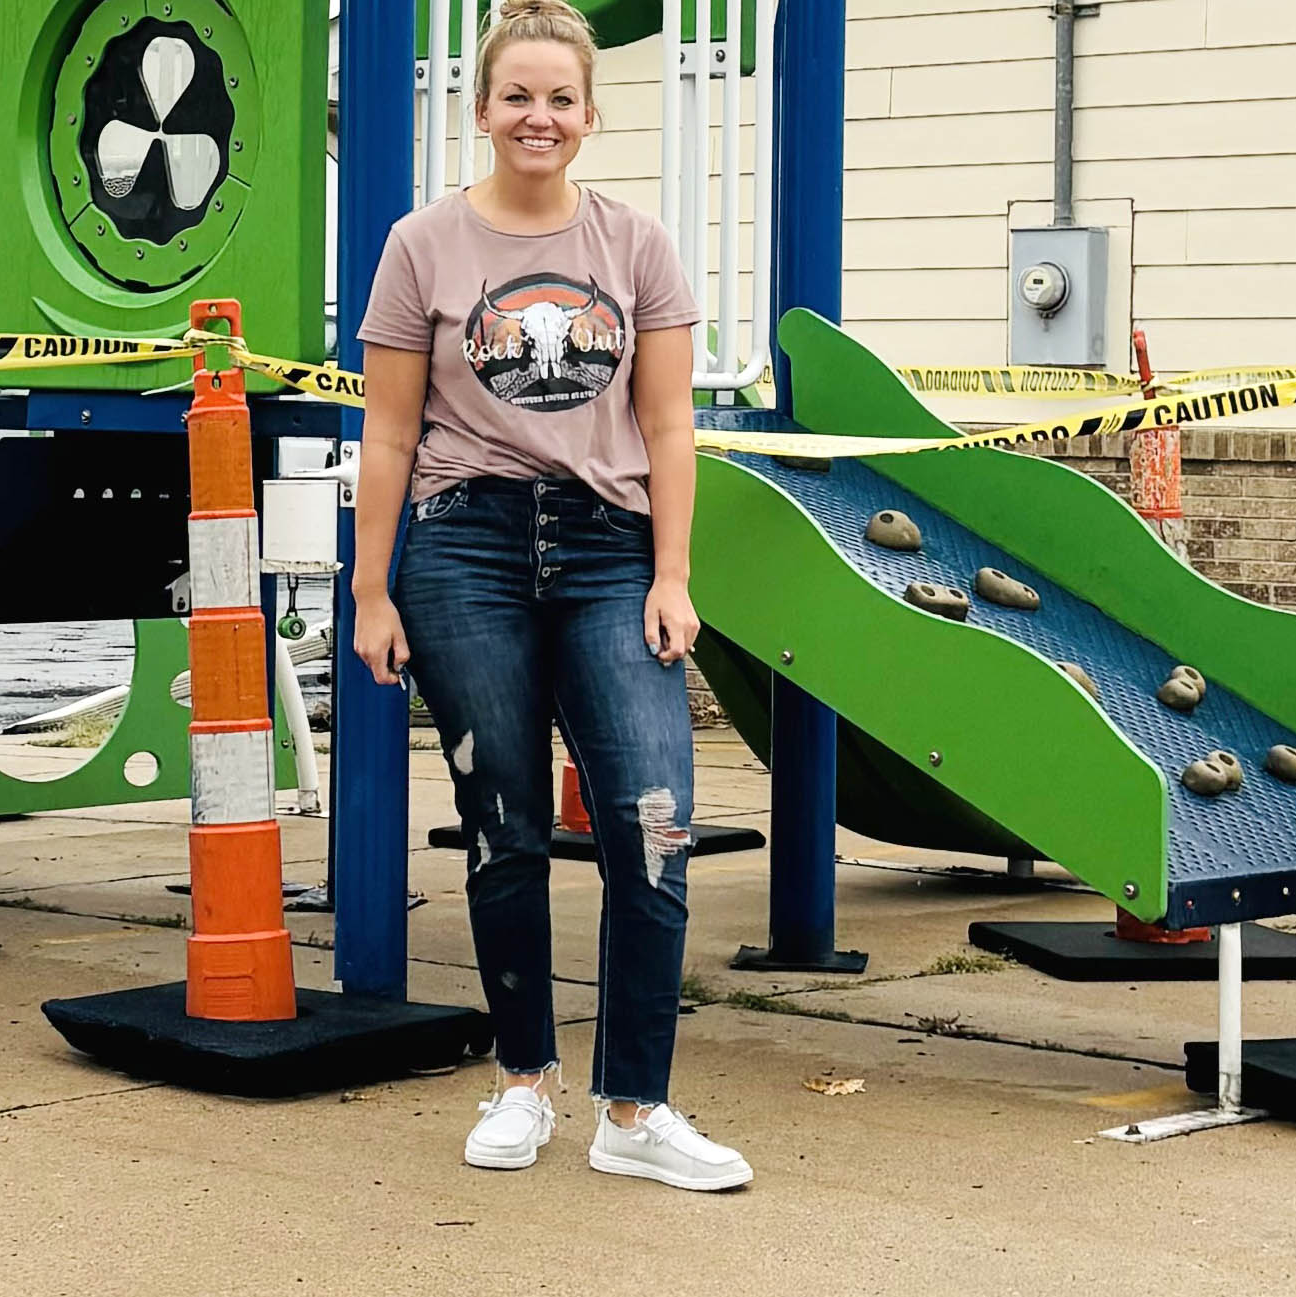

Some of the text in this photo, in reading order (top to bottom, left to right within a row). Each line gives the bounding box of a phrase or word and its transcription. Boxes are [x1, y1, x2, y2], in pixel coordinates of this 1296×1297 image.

[24, 337, 140, 358] CAUTION
[462, 326, 625, 362] Rock Out
[1153, 383, 1280, 426] CAUTION
